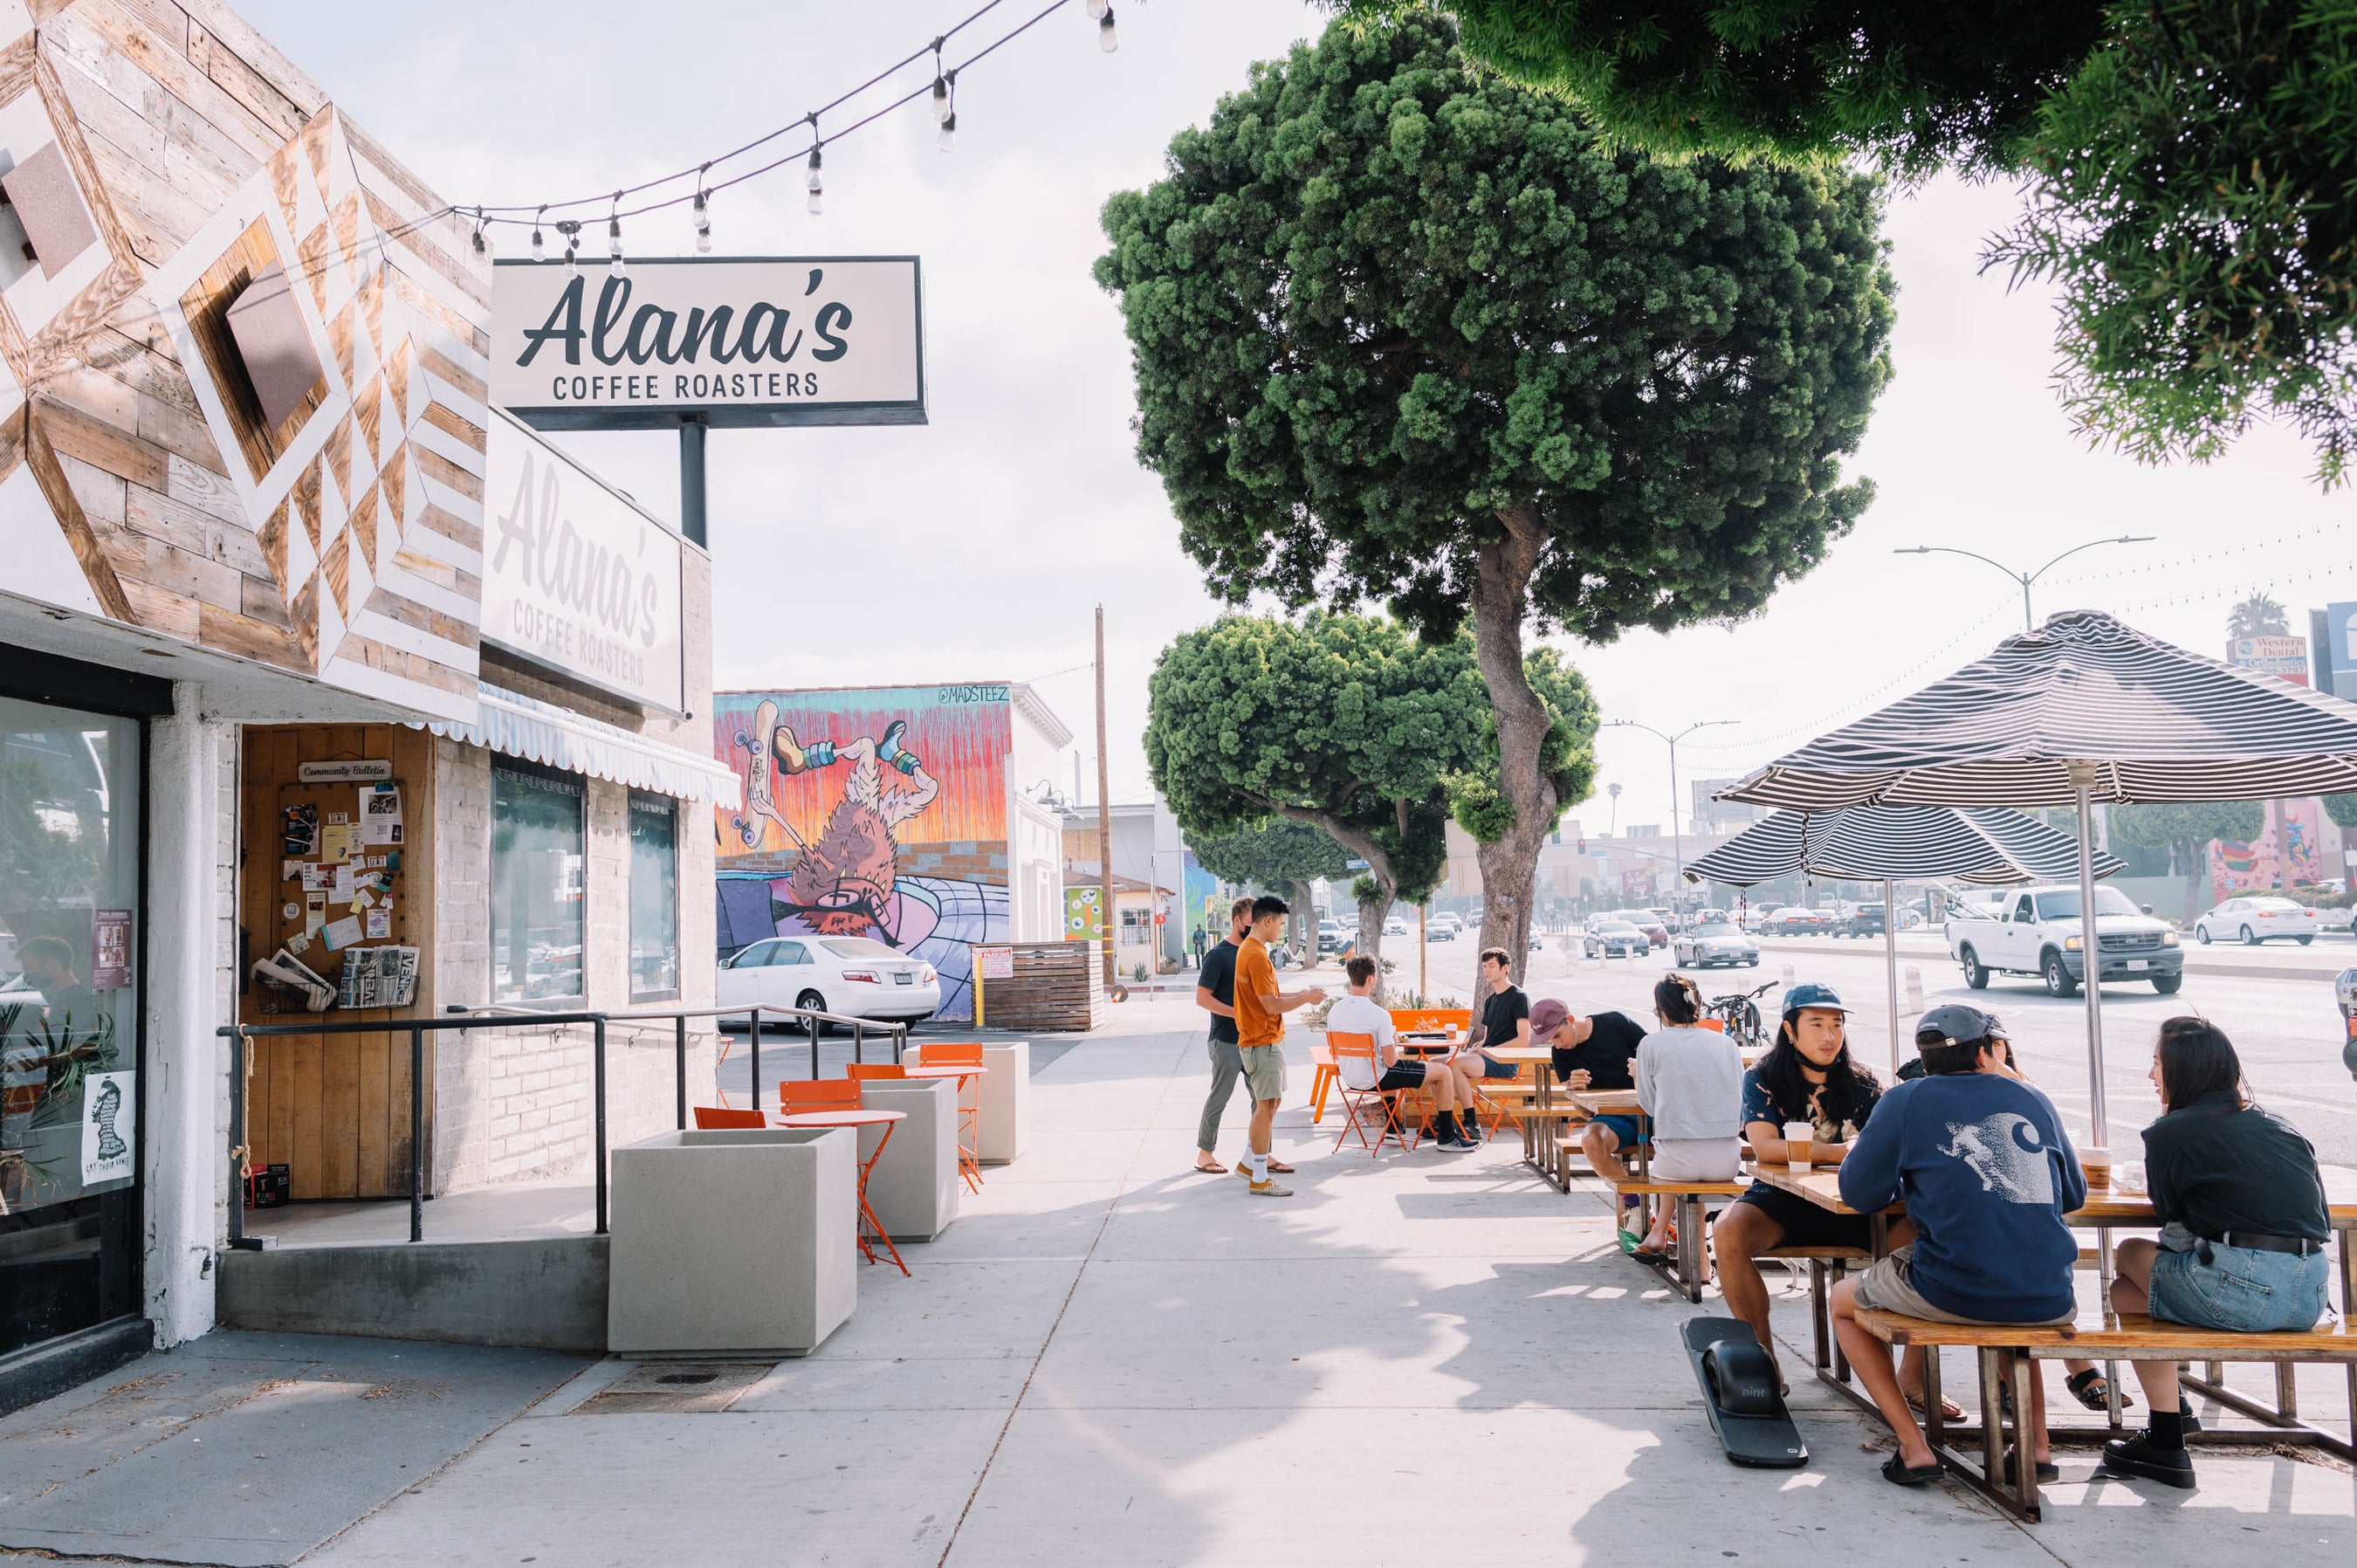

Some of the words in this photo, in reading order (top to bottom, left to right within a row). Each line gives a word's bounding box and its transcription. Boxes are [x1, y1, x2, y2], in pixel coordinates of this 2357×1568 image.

[516, 269, 852, 367] Alana's
[553, 375, 658, 400] COFFEE
[676, 372, 818, 398] ROASTERS
[492, 449, 657, 648] Alana's
[513, 598, 572, 655] COFFEE
[580, 629, 644, 687] ROASTERS
[2257, 638, 2303, 647] Western
[2264, 647, 2299, 657] Dental
[938, 685, 1010, 704] @MADSTEEZ
[304, 767, 349, 777] Community
[352, 766, 386, 777] Bulletin
[86, 1162, 97, 1176] SAY
[100, 1160, 114, 1172] THEIR
[1742, 1386, 1766, 1398] pint
